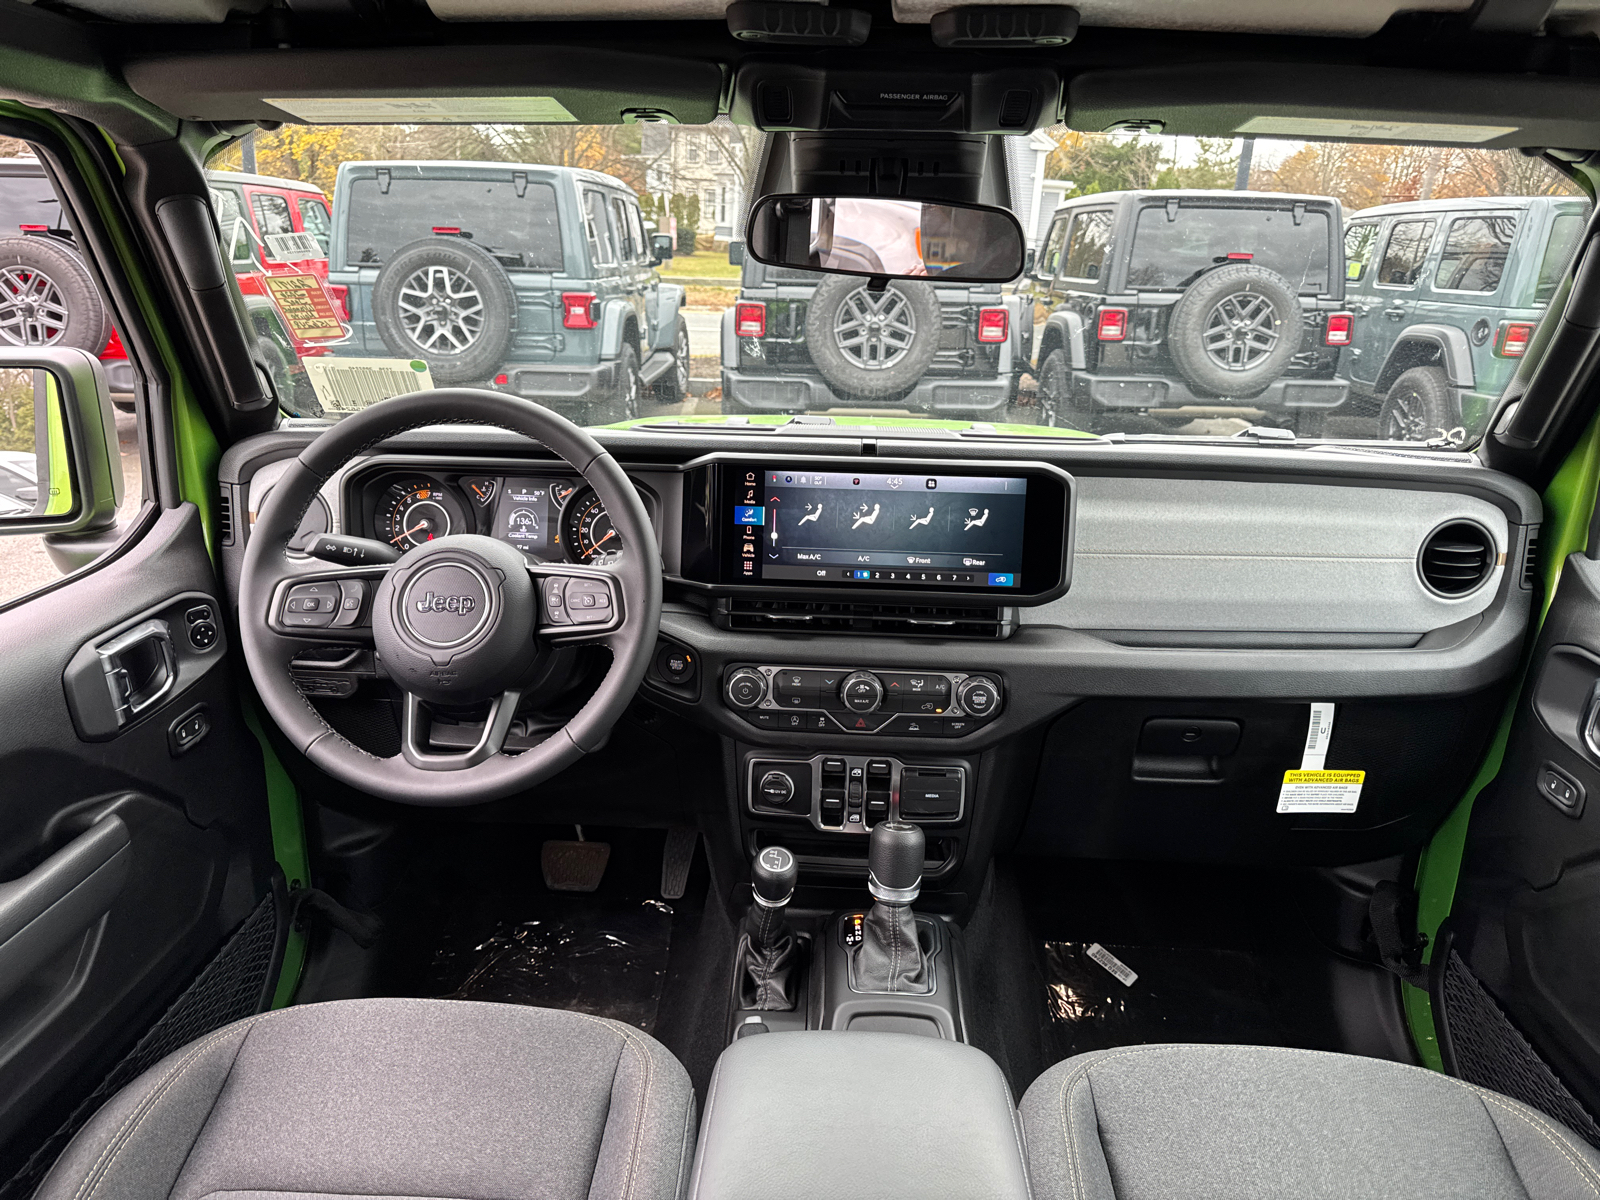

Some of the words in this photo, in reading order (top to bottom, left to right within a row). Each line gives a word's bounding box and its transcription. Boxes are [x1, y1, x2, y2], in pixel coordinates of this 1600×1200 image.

[886, 477, 903, 485] 4:45
[395, 524, 400, 532] 2
[915, 556, 931, 564] Front
[972, 558, 986, 567] Rear
[415, 591, 476, 616] Jeep
